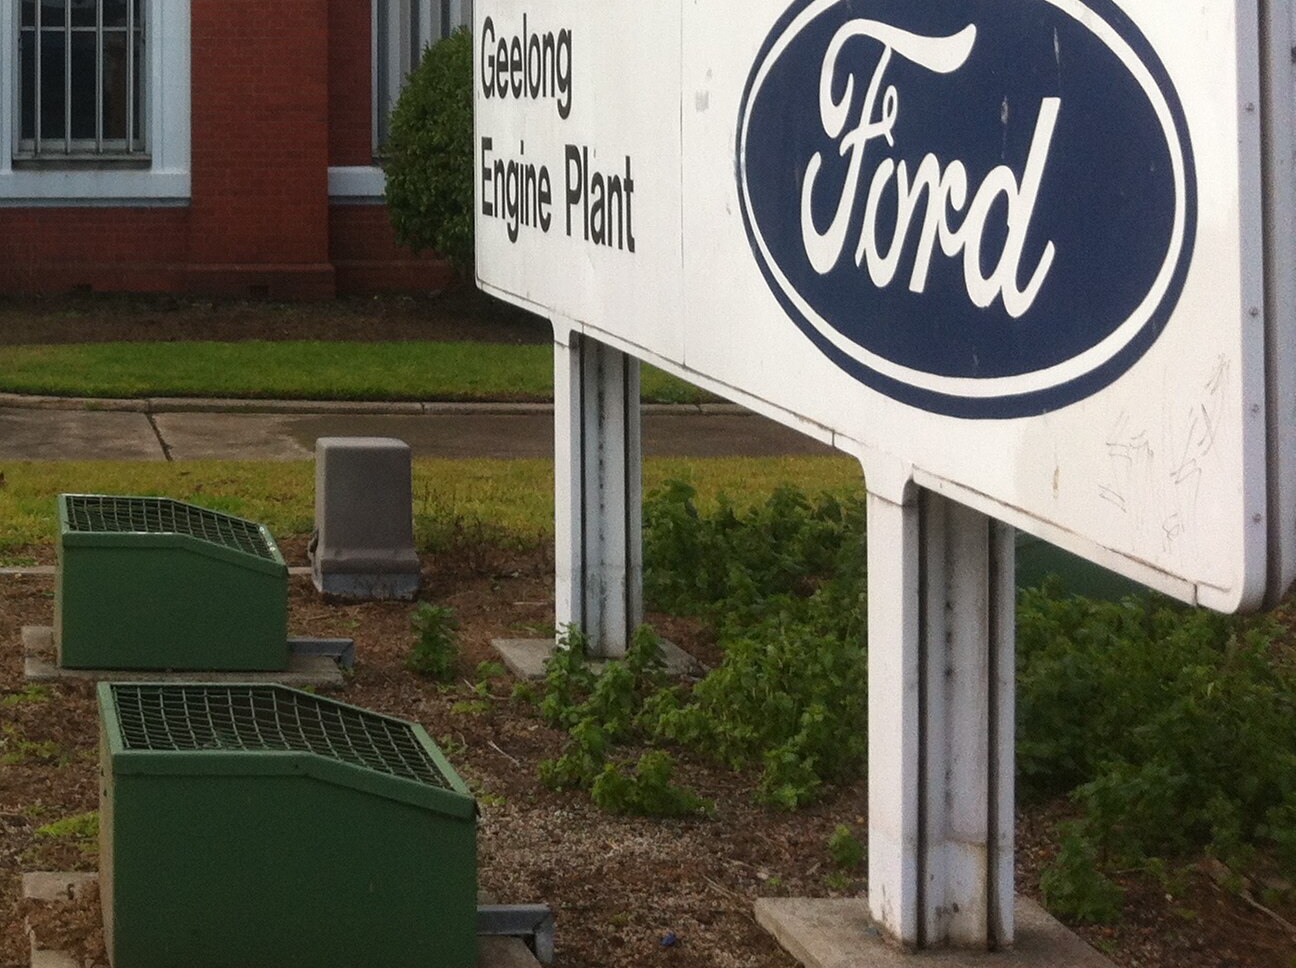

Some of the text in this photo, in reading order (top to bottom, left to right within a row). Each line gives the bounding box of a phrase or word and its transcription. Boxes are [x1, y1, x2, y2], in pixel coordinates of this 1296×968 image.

[481, 12, 572, 120] Geelong
[481, 136, 636, 253] Engine Plant
[801, 18, 1061, 318] Ford
